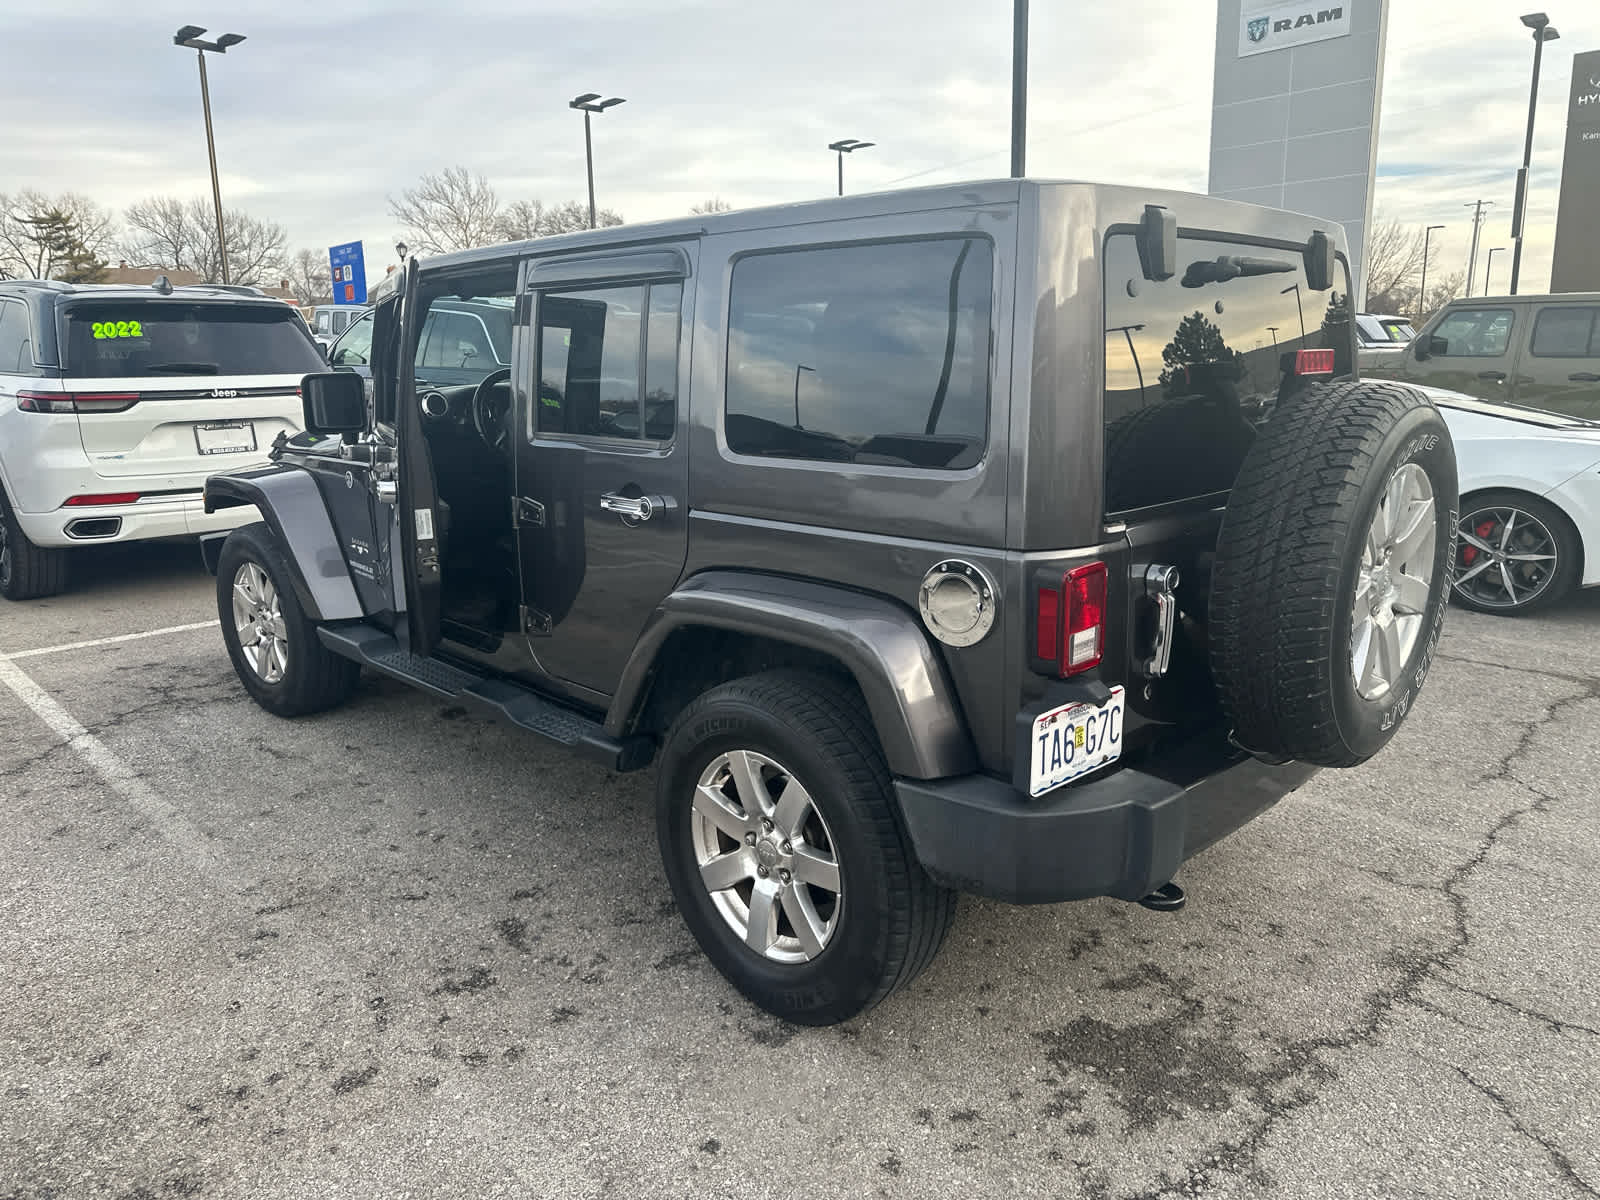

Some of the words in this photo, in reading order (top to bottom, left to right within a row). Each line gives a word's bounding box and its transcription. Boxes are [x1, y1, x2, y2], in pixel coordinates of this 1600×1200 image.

[1273, 8, 1342, 32] RAM
[1578, 94, 1600, 105] HY
[92, 320, 143, 339] 2022
[211, 388, 237, 398] Jeep
